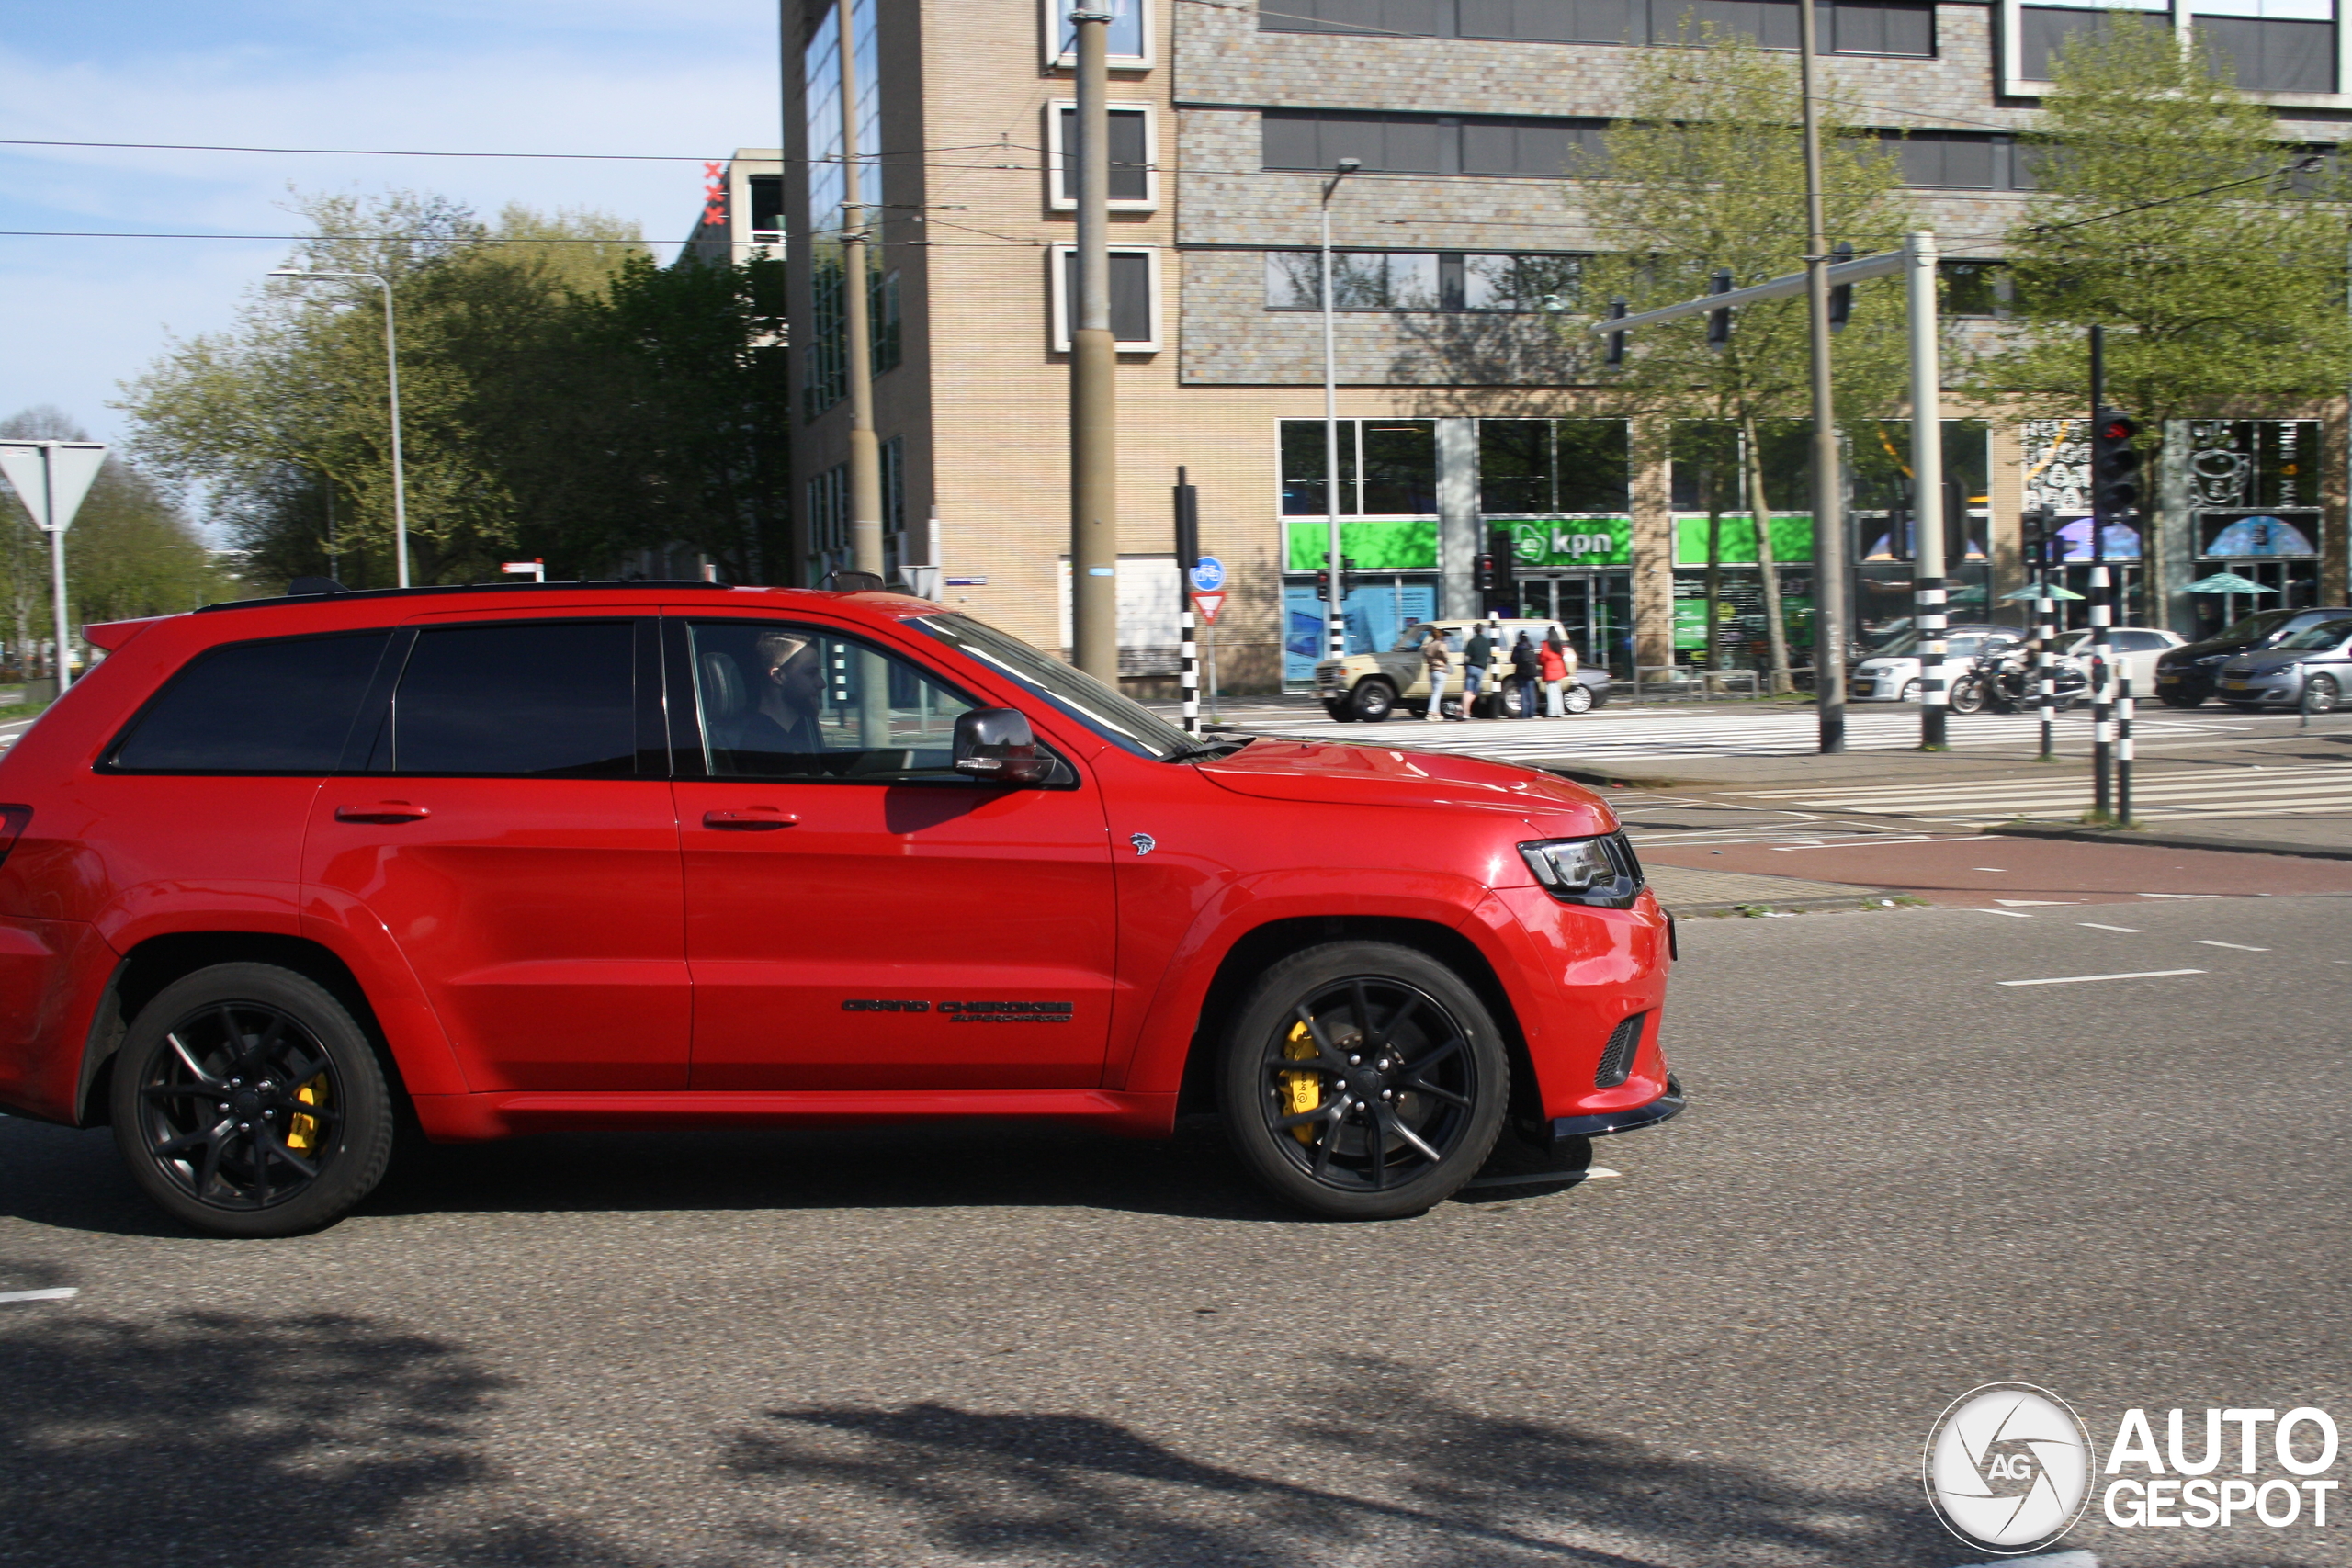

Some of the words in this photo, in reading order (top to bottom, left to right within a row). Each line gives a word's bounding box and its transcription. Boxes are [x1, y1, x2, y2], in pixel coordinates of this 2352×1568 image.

[1551, 528, 1612, 558] kpn
[842, 999, 931, 1011] GRAND
[938, 1001, 1074, 1012] CHEROKEE
[949, 1013, 1074, 1022] SUPERCHARGED
